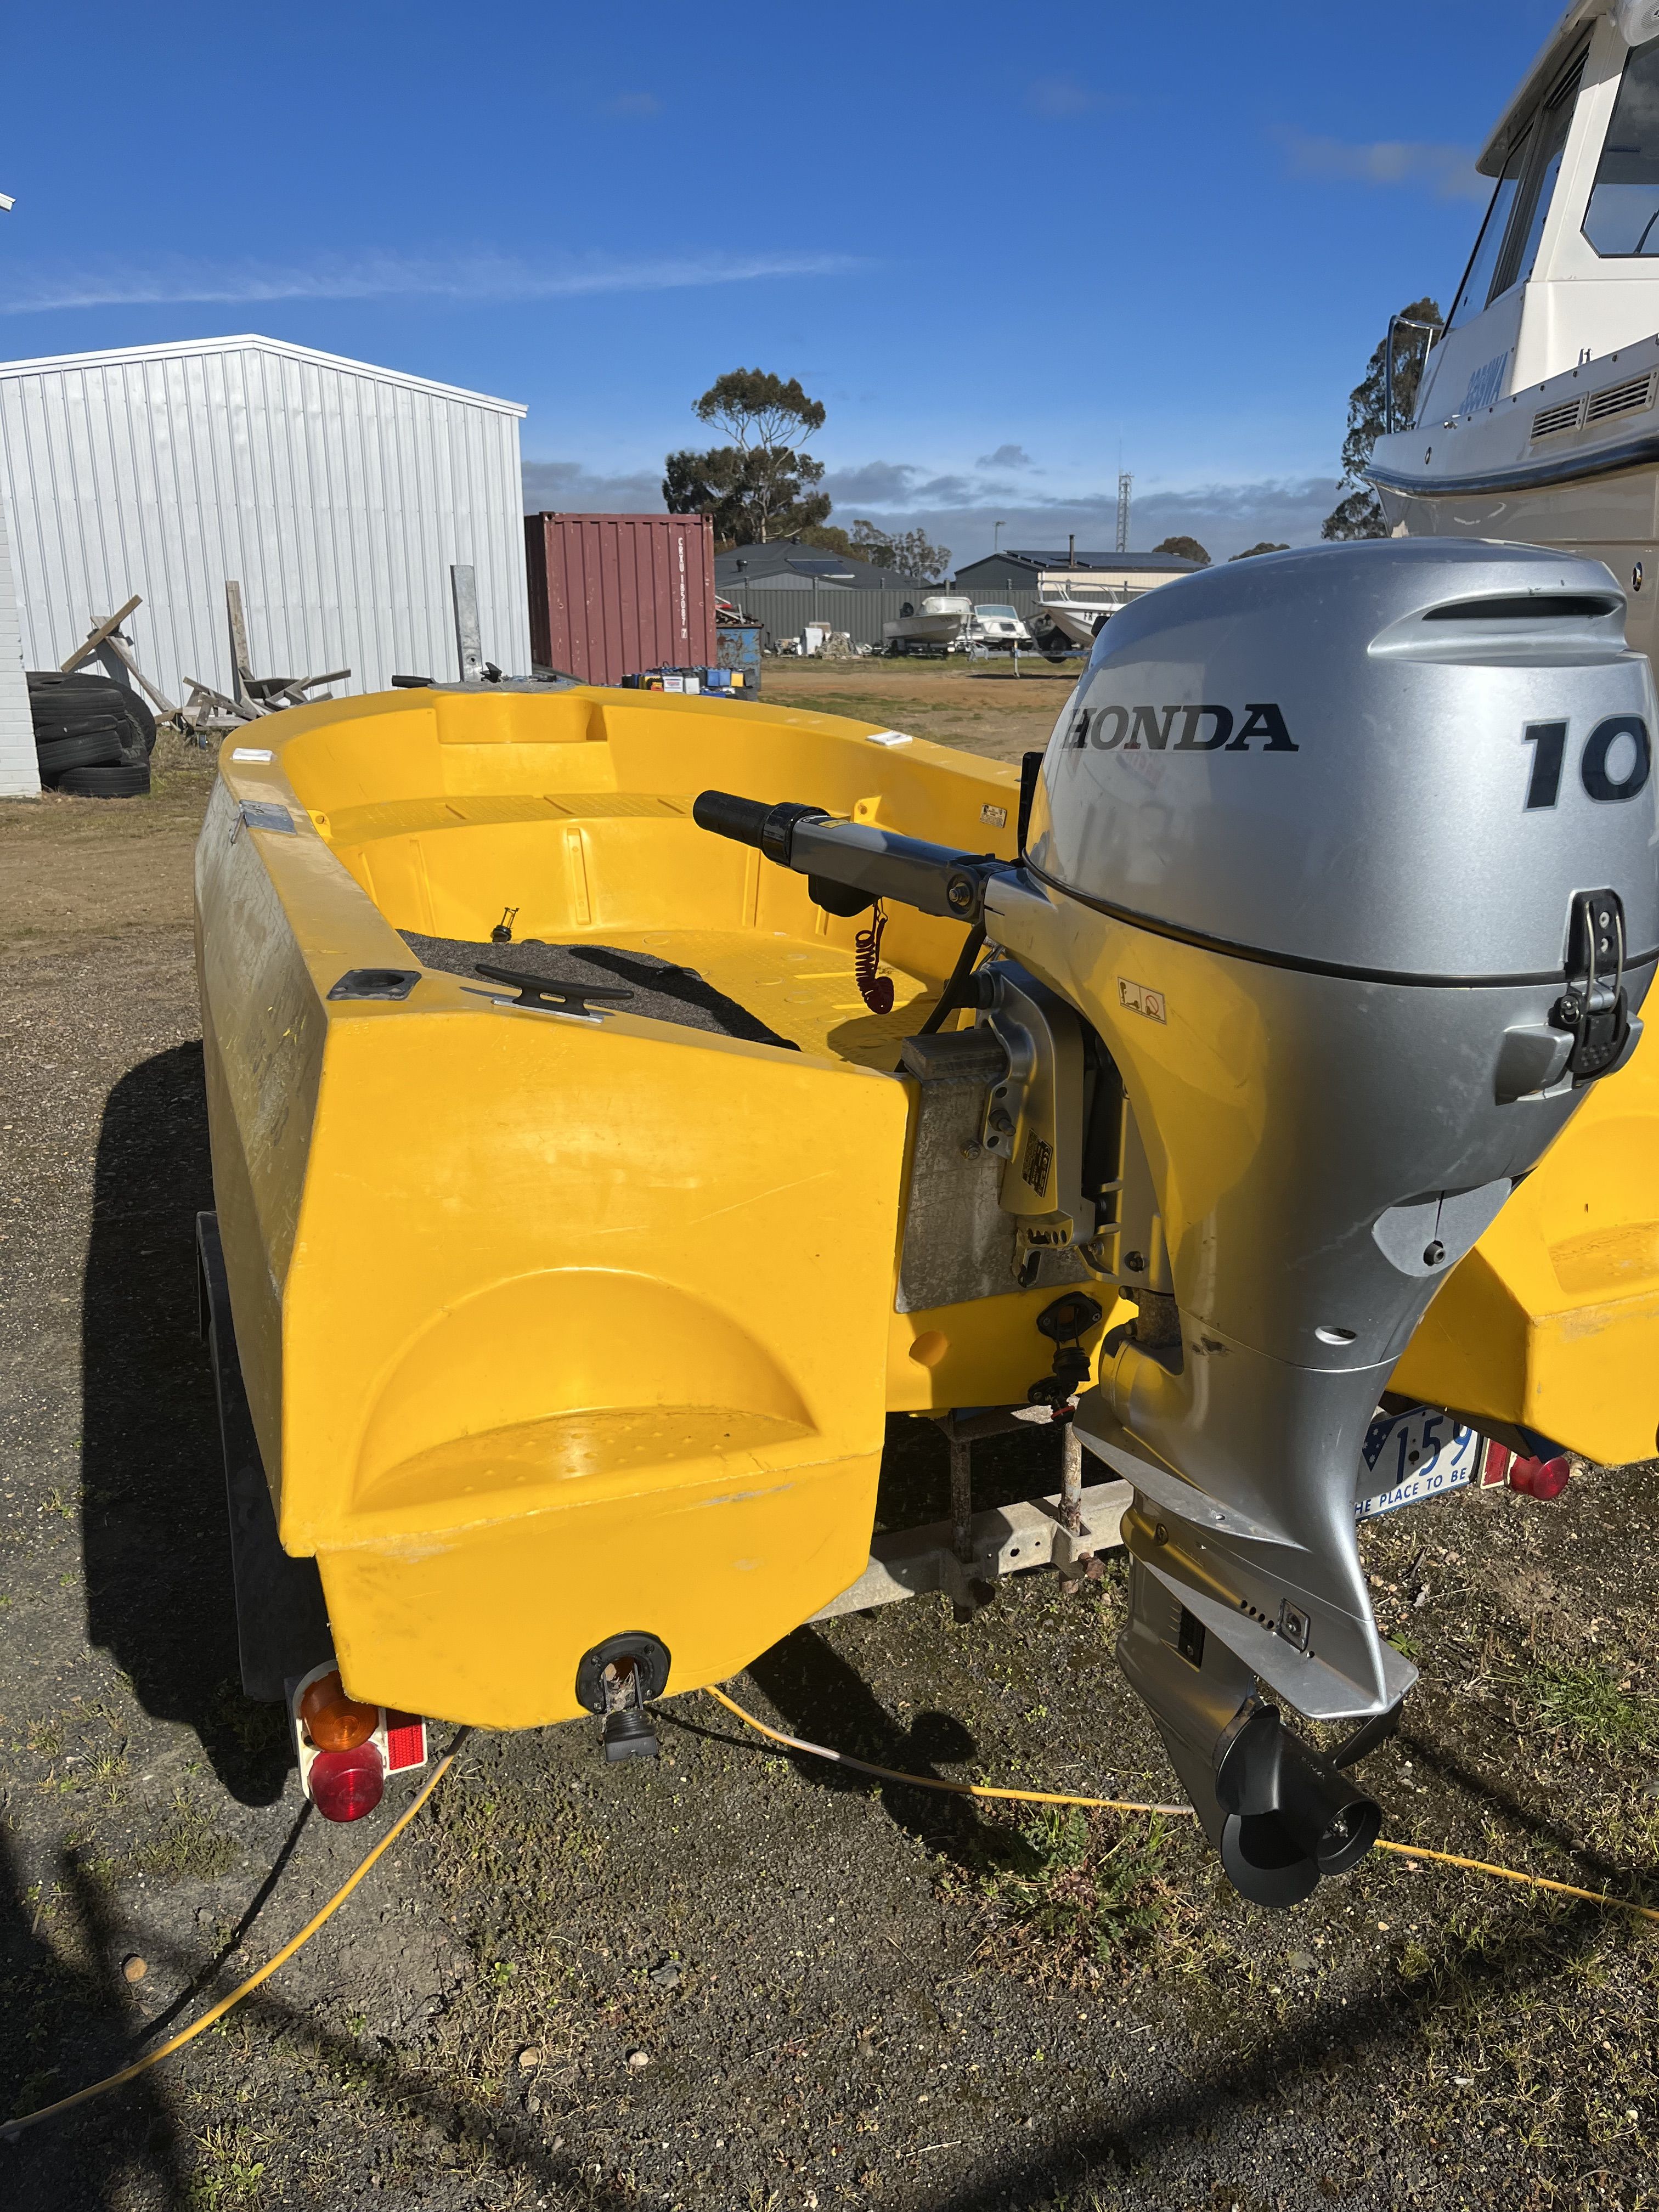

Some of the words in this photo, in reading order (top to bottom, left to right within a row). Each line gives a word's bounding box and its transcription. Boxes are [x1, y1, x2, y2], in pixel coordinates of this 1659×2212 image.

[1060, 703, 1300, 752] HONDA
[1523, 715, 1650, 811] 10
[1355, 1499, 1371, 1514] HE
[1379, 1482, 1419, 1507] PLACE
[1427, 1475, 1443, 1490] TO
[1451, 1468, 1467, 1482] BE
